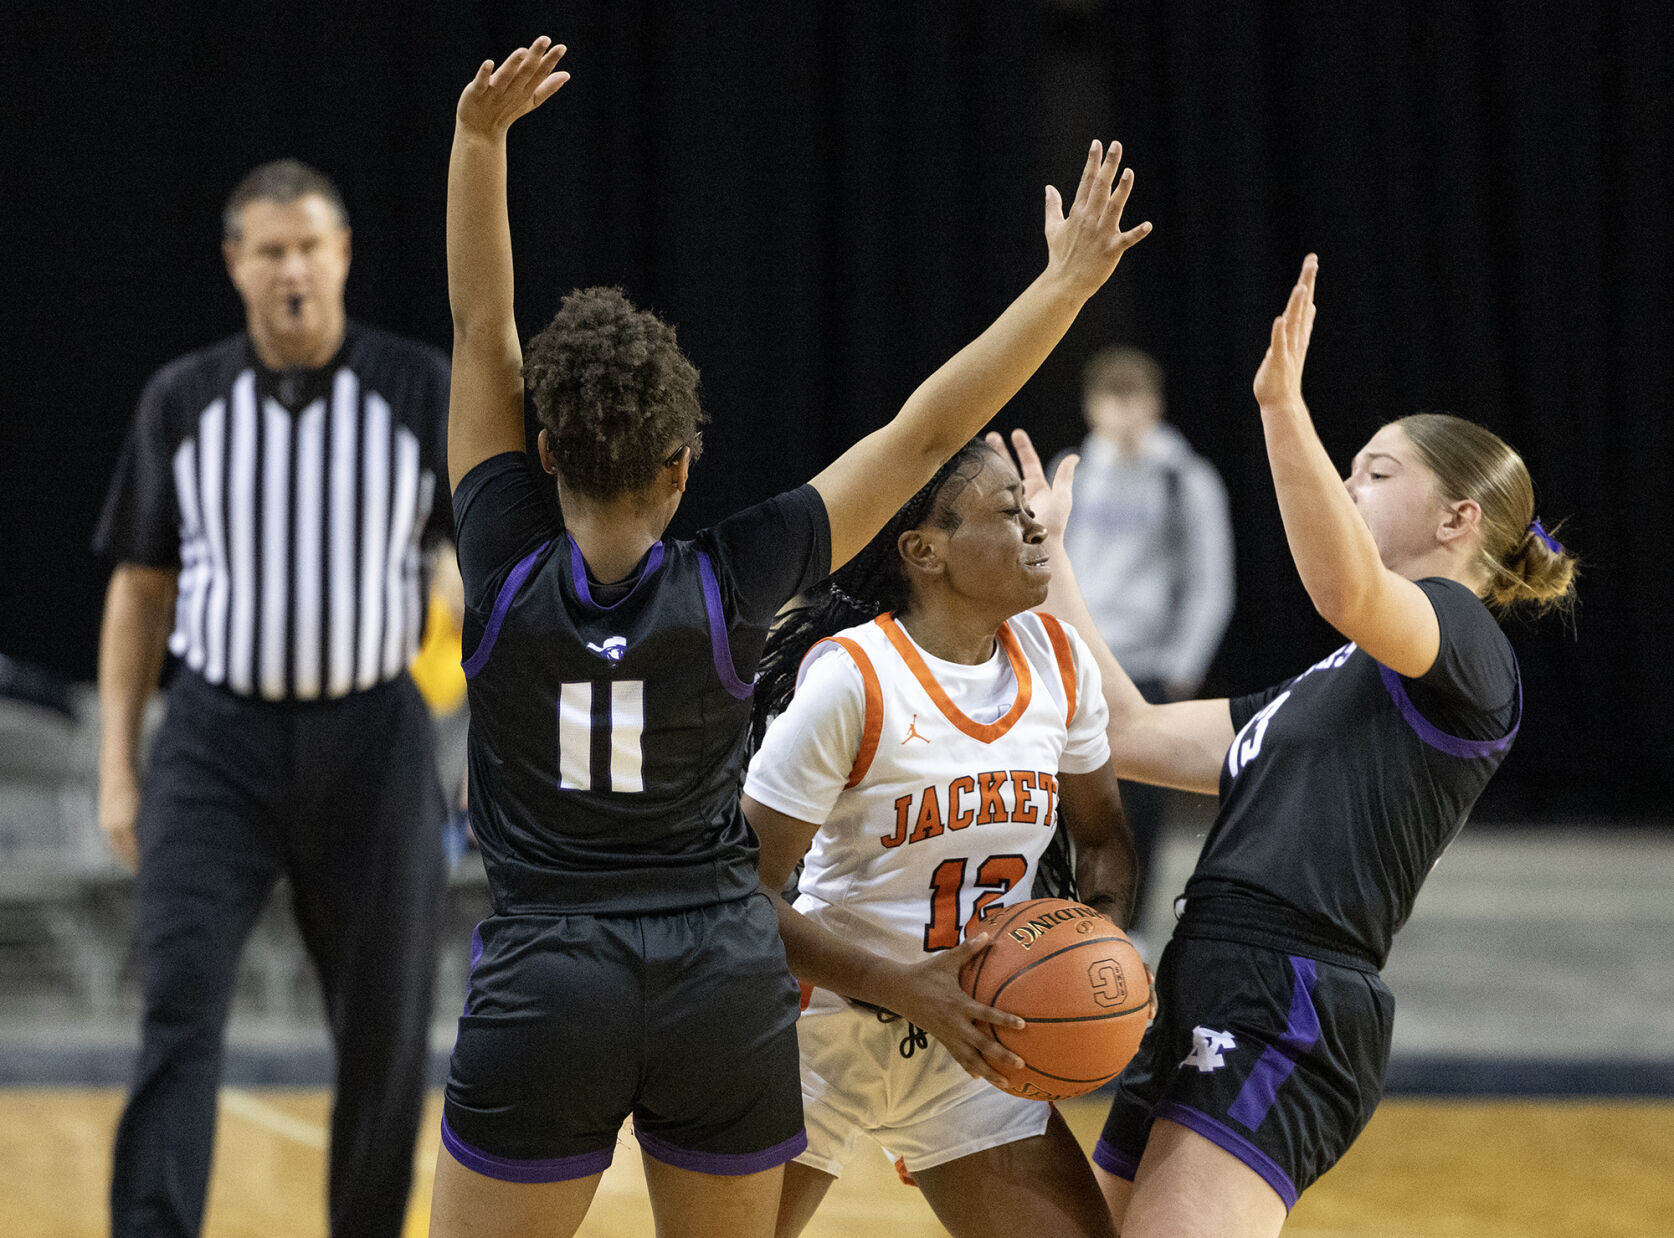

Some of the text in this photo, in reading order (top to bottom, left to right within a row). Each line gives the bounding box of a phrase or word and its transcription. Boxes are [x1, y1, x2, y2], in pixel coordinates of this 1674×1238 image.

[559, 680, 645, 793] 11
[880, 769, 1059, 849] JACKET
[923, 853, 1028, 953] 12
